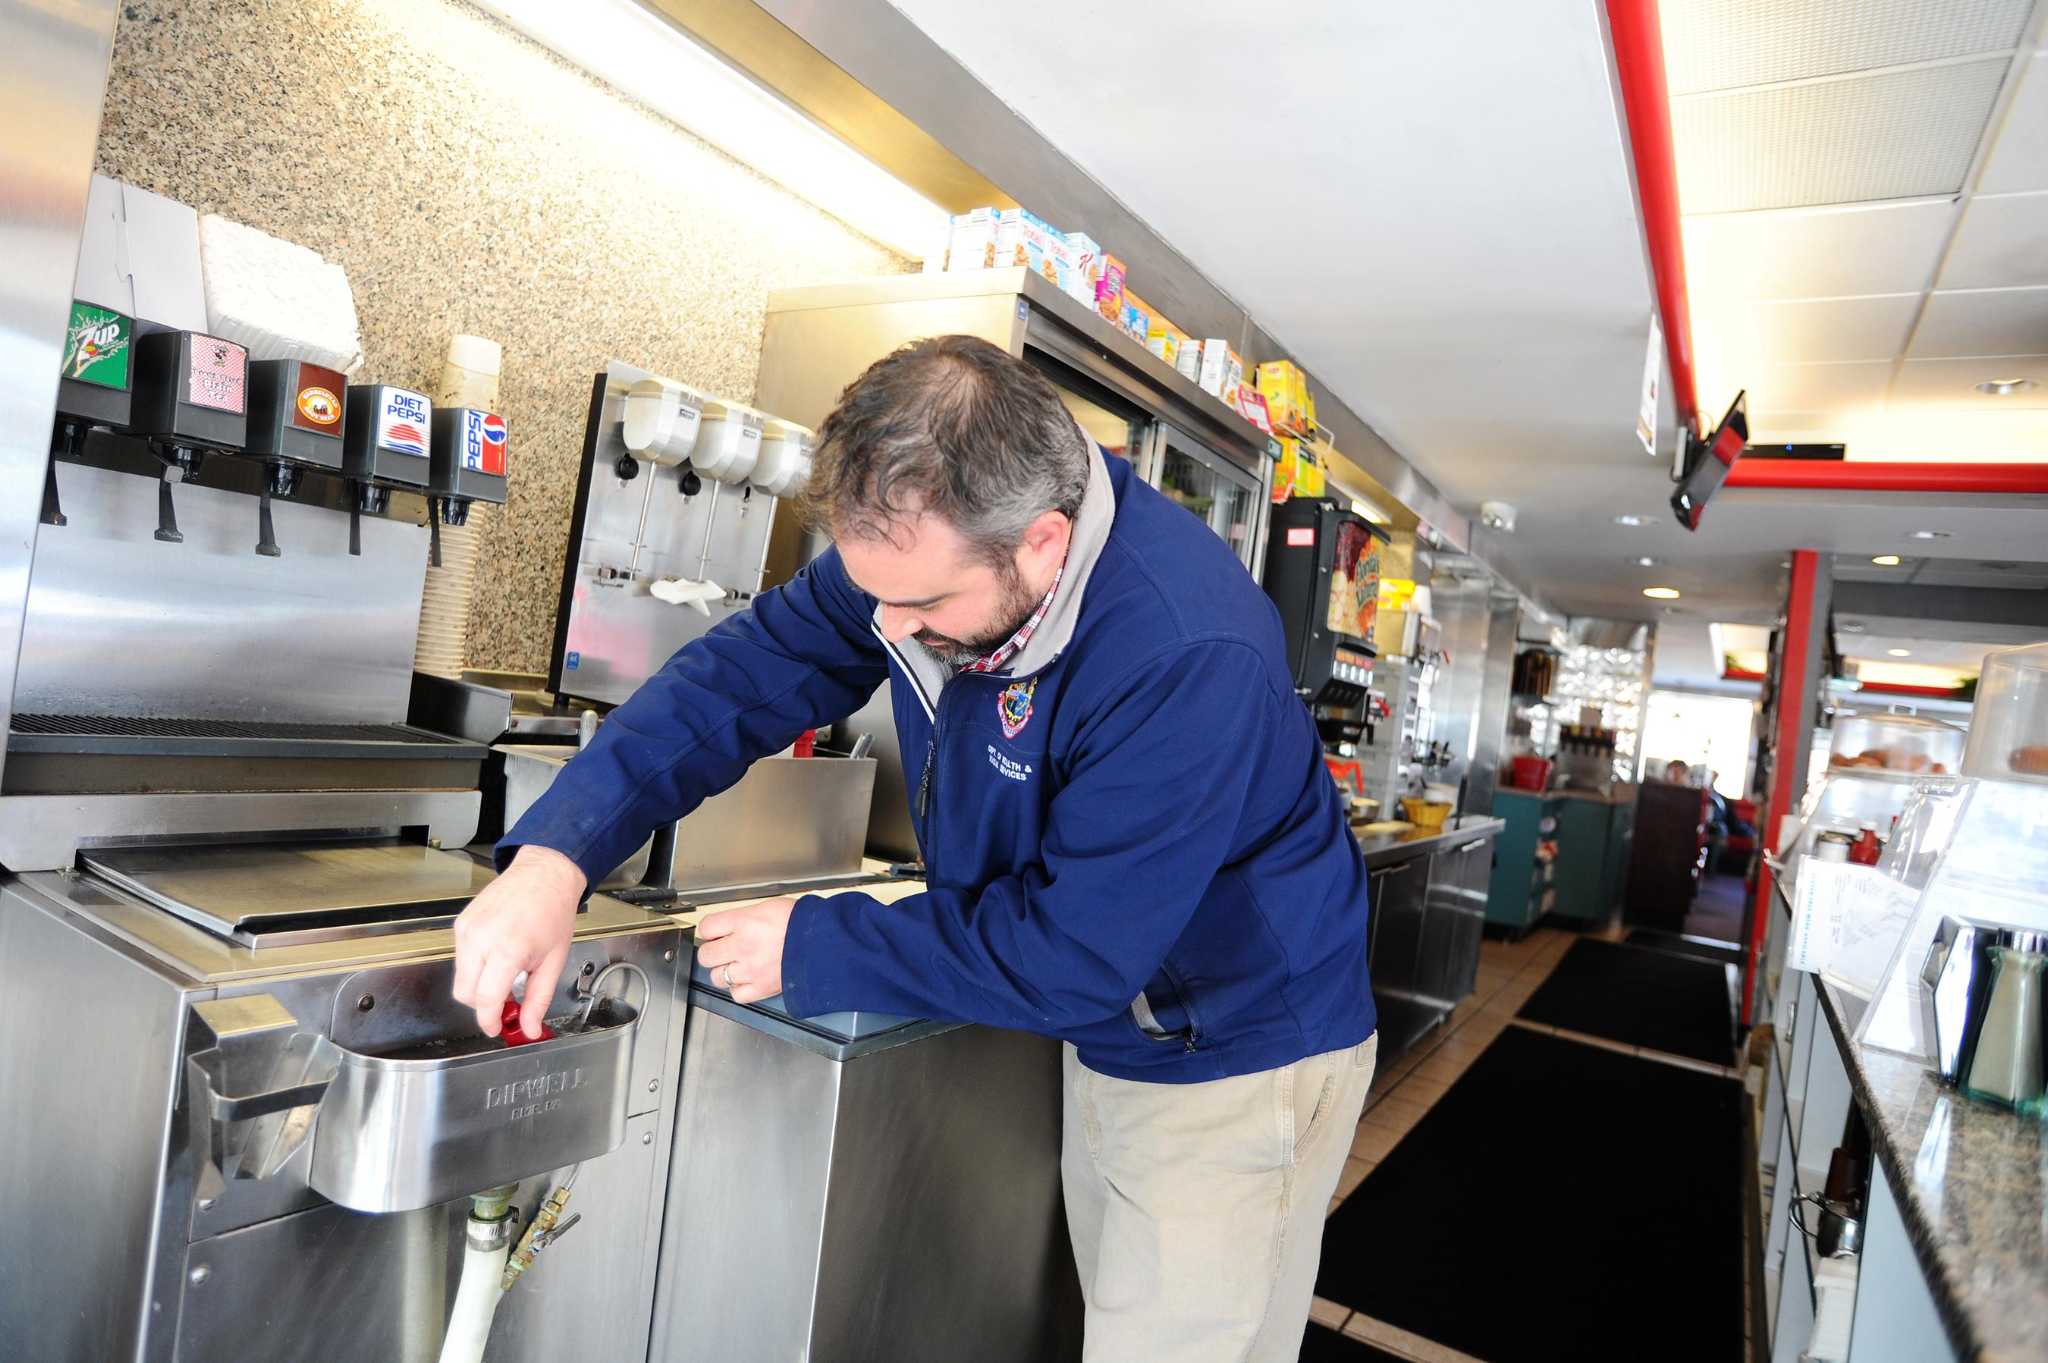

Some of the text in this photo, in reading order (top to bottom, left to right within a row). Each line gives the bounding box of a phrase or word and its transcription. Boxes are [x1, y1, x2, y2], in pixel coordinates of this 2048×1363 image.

[387, 404, 426, 424] PEPSI
[394, 394, 424, 411] DIET
[467, 410, 482, 471] PEPSI
[486, 1068, 589, 1110] DIPWELL
